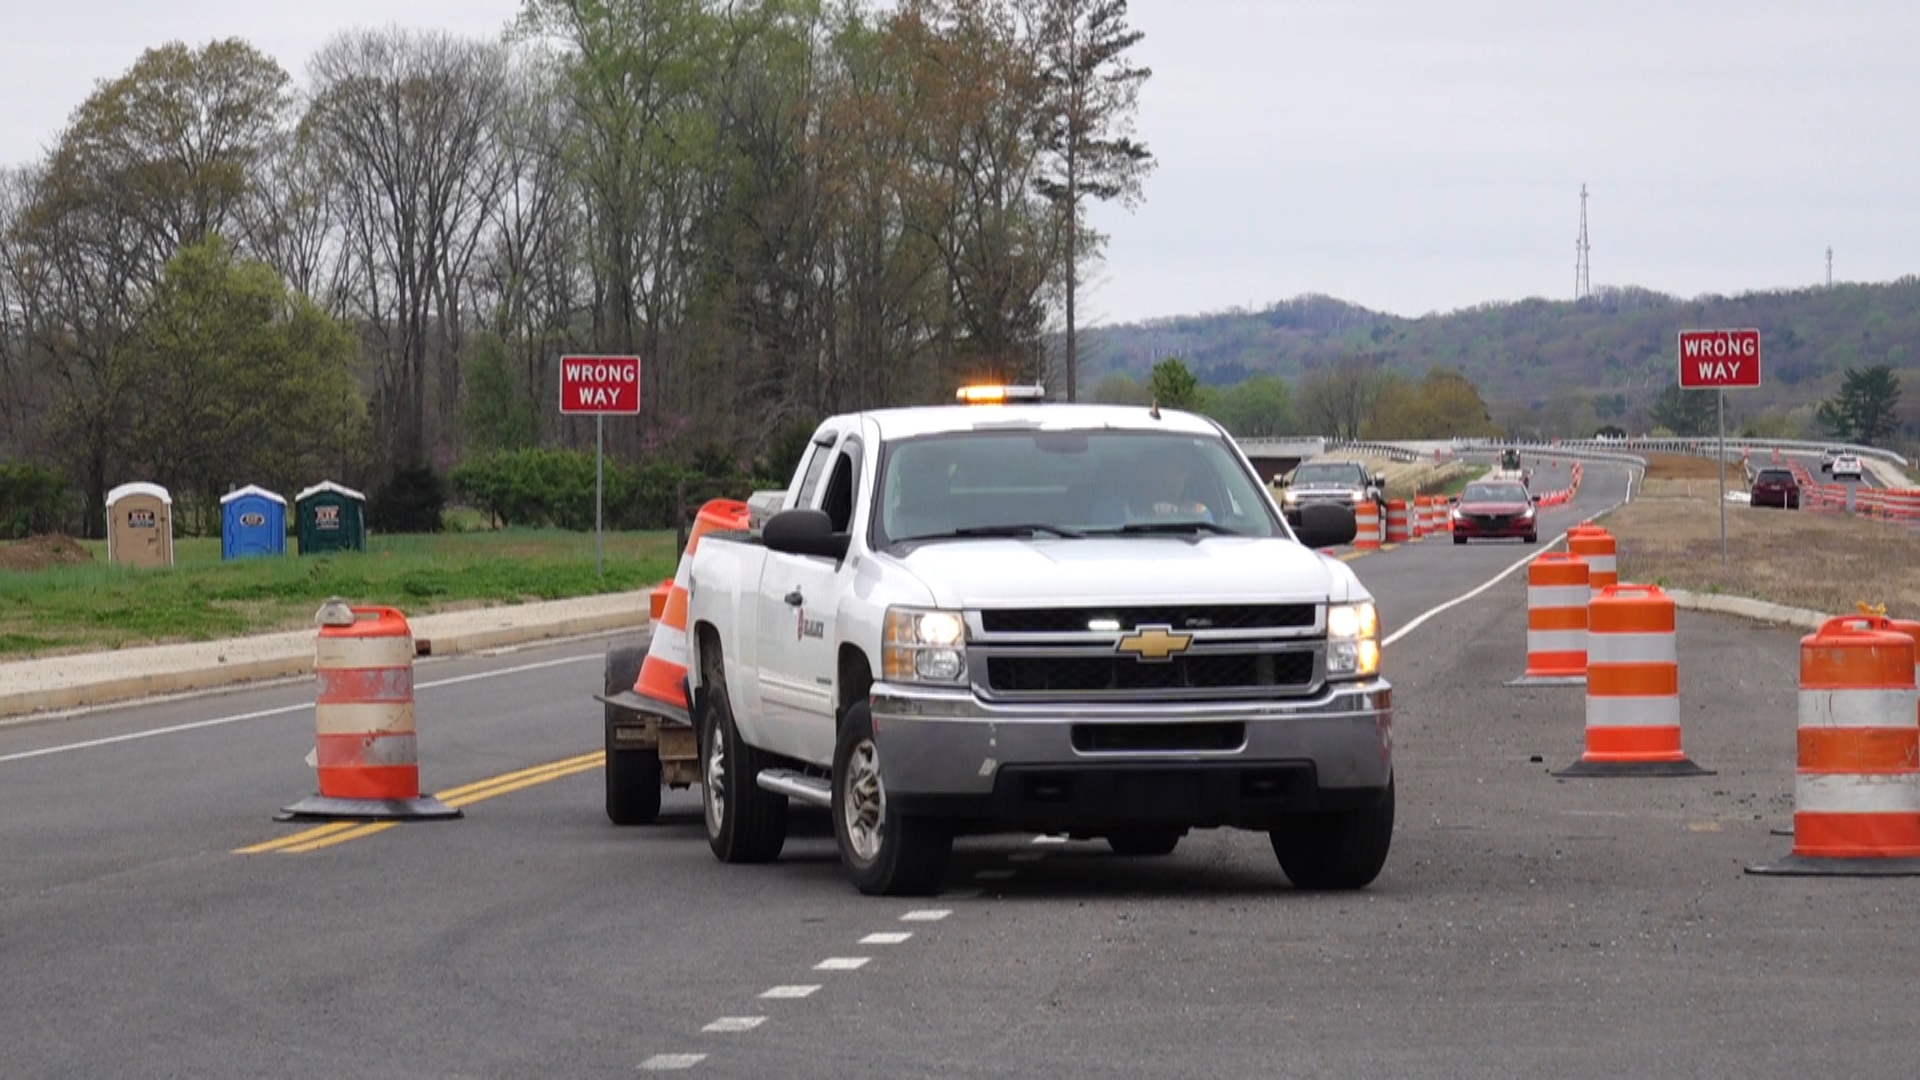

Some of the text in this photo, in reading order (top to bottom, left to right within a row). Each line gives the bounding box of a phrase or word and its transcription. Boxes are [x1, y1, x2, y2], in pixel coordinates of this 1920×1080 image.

[1684, 338, 1755, 357] WRONG
[566, 364, 635, 383] WRONG
[1698, 361, 1741, 380] WAY
[579, 387, 621, 405] WAY
